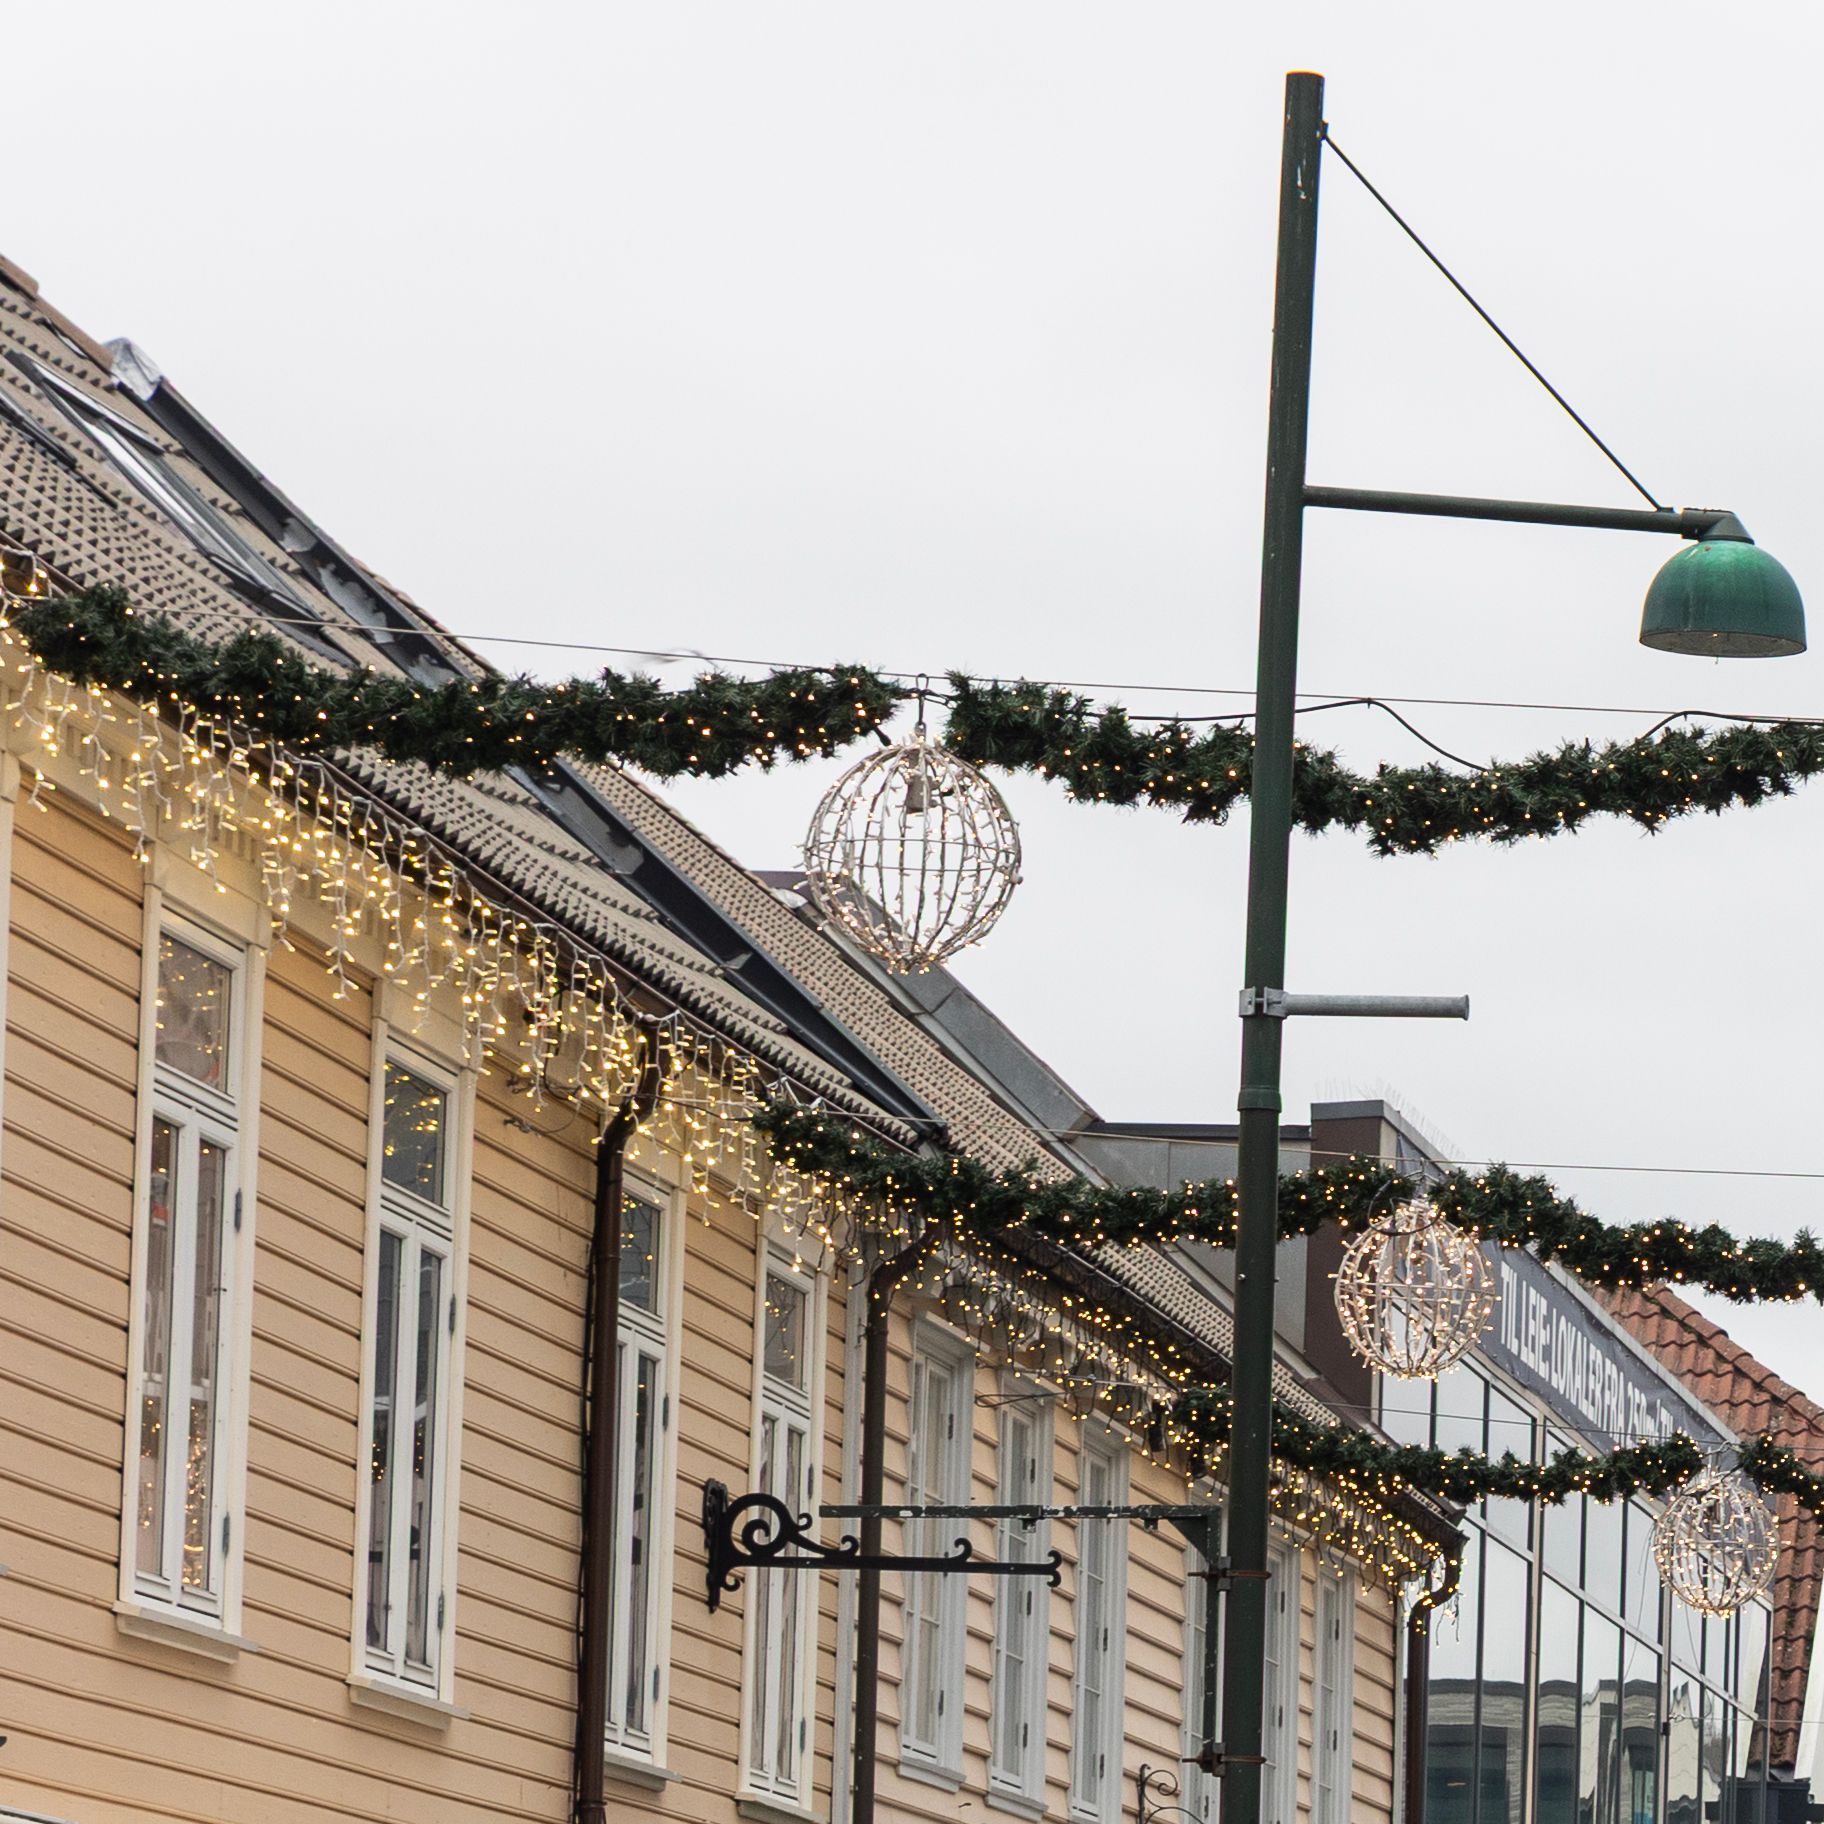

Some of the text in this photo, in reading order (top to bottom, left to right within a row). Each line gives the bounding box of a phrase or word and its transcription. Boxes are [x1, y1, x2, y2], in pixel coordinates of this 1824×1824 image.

[1500, 1260, 1519, 1356] TIL
[1520, 1279, 1550, 1382] LEIE:
[1551, 1307, 1603, 1429] LOKALER
[1603, 1357, 1626, 1451] FRA
